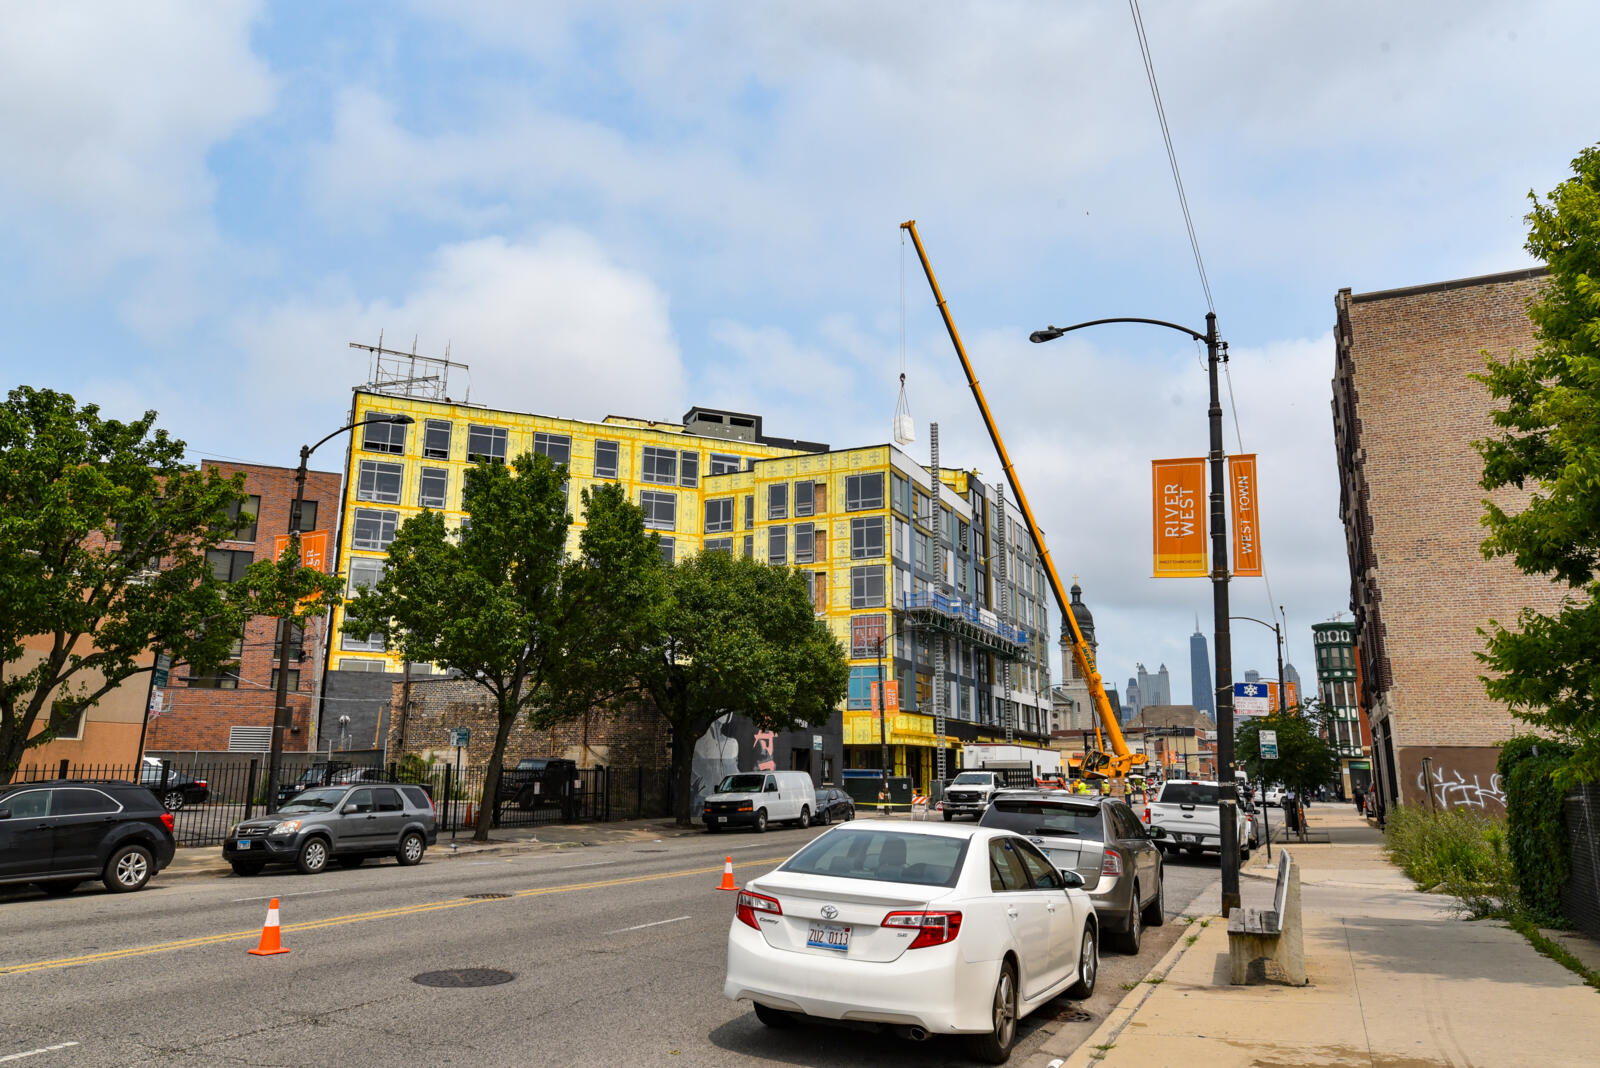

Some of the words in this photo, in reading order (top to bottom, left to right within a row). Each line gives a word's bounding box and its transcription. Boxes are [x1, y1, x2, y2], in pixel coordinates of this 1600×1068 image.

[1164, 484, 1179, 537] RIVER
[1238, 475, 1250, 511] TOWN
[1180, 487, 1194, 537] WEST
[1240, 518, 1253, 554] WEST
[1082, 647, 1096, 674] IMPERIAL
[808, 928, 825, 943] ZUZ
[828, 931, 849, 945] 0113
